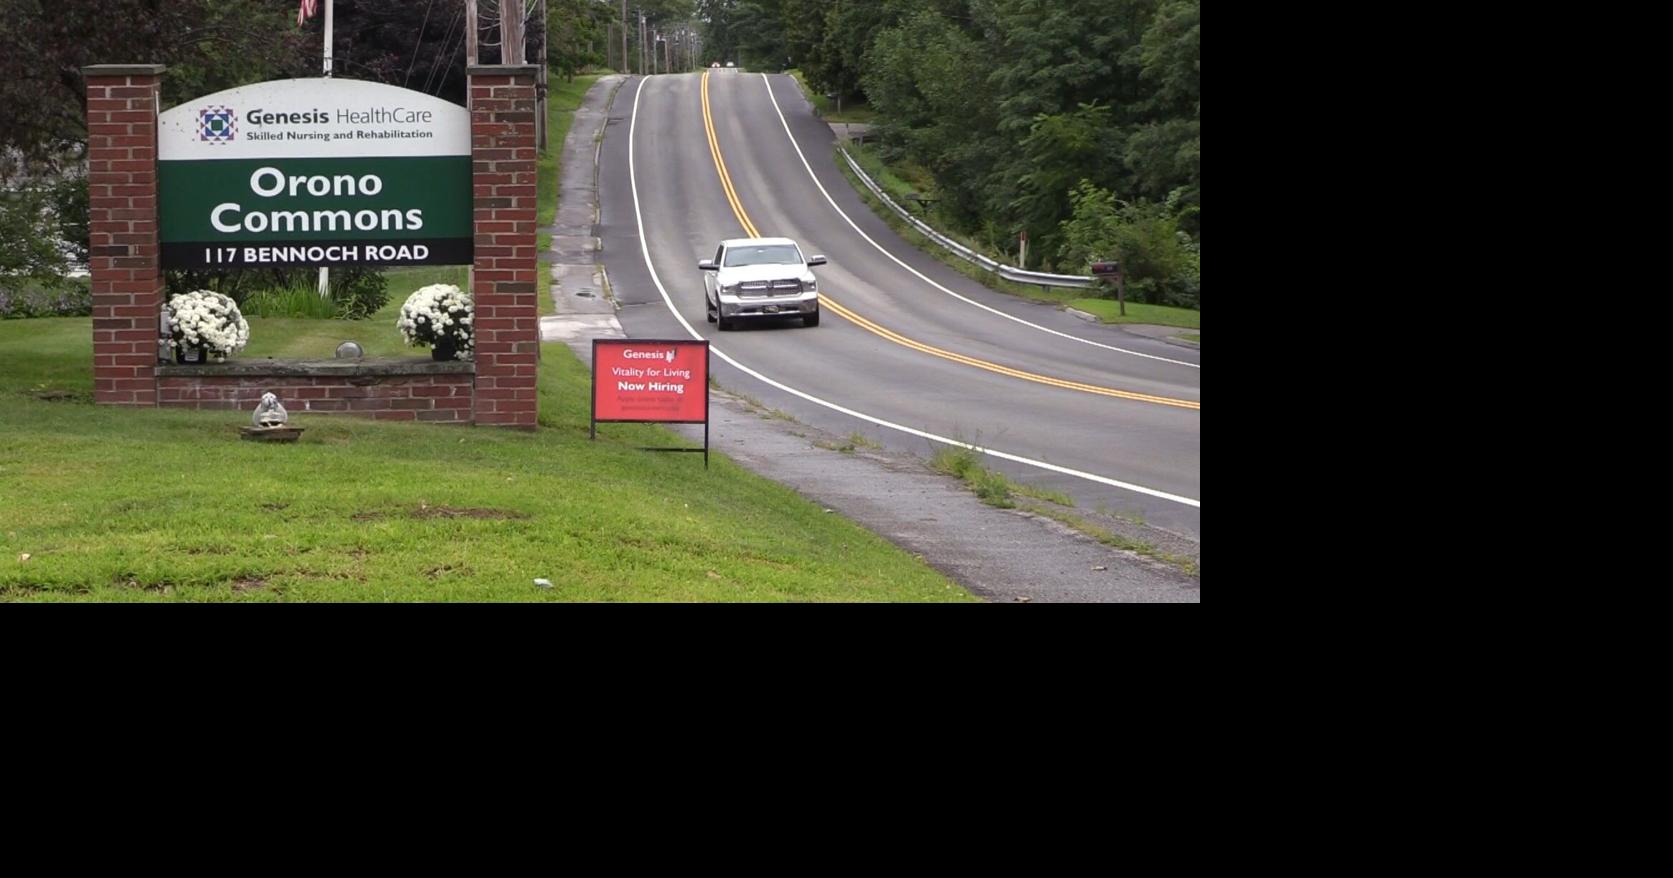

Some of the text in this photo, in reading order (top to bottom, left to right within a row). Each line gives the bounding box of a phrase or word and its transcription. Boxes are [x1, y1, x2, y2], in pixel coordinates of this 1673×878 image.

[246, 107, 432, 125] Genesis HealthCare
[246, 129, 433, 141] Skilled Nursing and Rehabilitation
[250, 166, 383, 197] Orono
[210, 202, 423, 233] Commons
[205, 244, 429, 263] 117 BENNOCH ROAD
[623, 349, 664, 359] Genesis
[612, 367, 690, 379] Vitality for Living
[618, 381, 684, 394] Now Hiring
